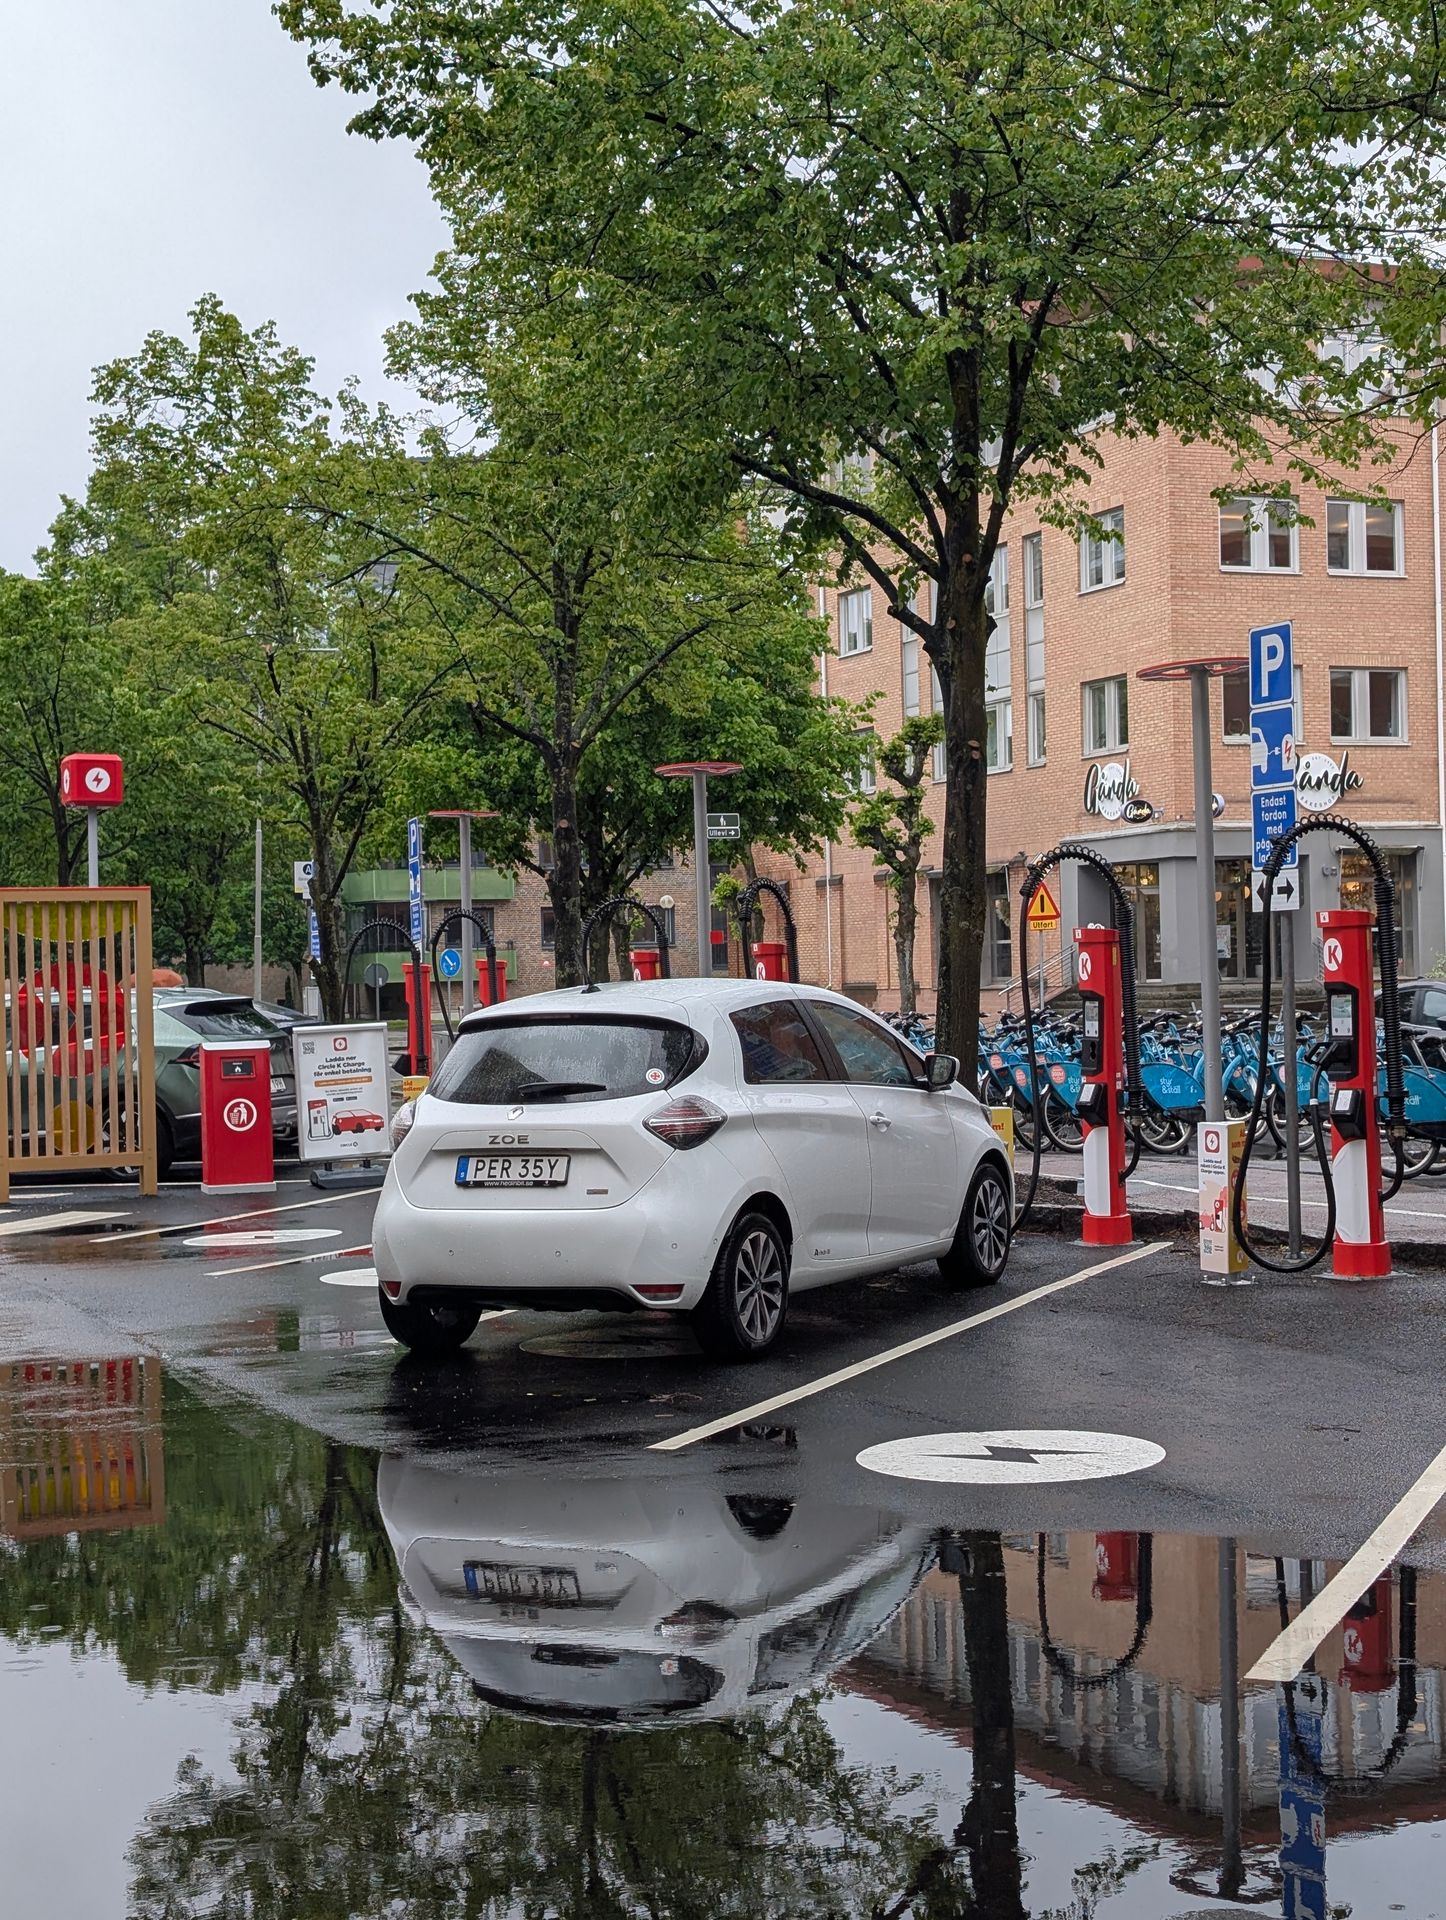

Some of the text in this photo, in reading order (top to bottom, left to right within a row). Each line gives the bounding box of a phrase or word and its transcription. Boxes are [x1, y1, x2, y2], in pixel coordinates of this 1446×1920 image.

[1260, 633, 1285, 698] P
[1295, 749, 1365, 799] årda
[1260, 794, 1287, 808] Endast
[1261, 809, 1287, 822] fordon
[1266, 822, 1283, 835] med
[488, 1134, 530, 1145] ZOE
[474, 1159, 559, 1178] PER 35Y
